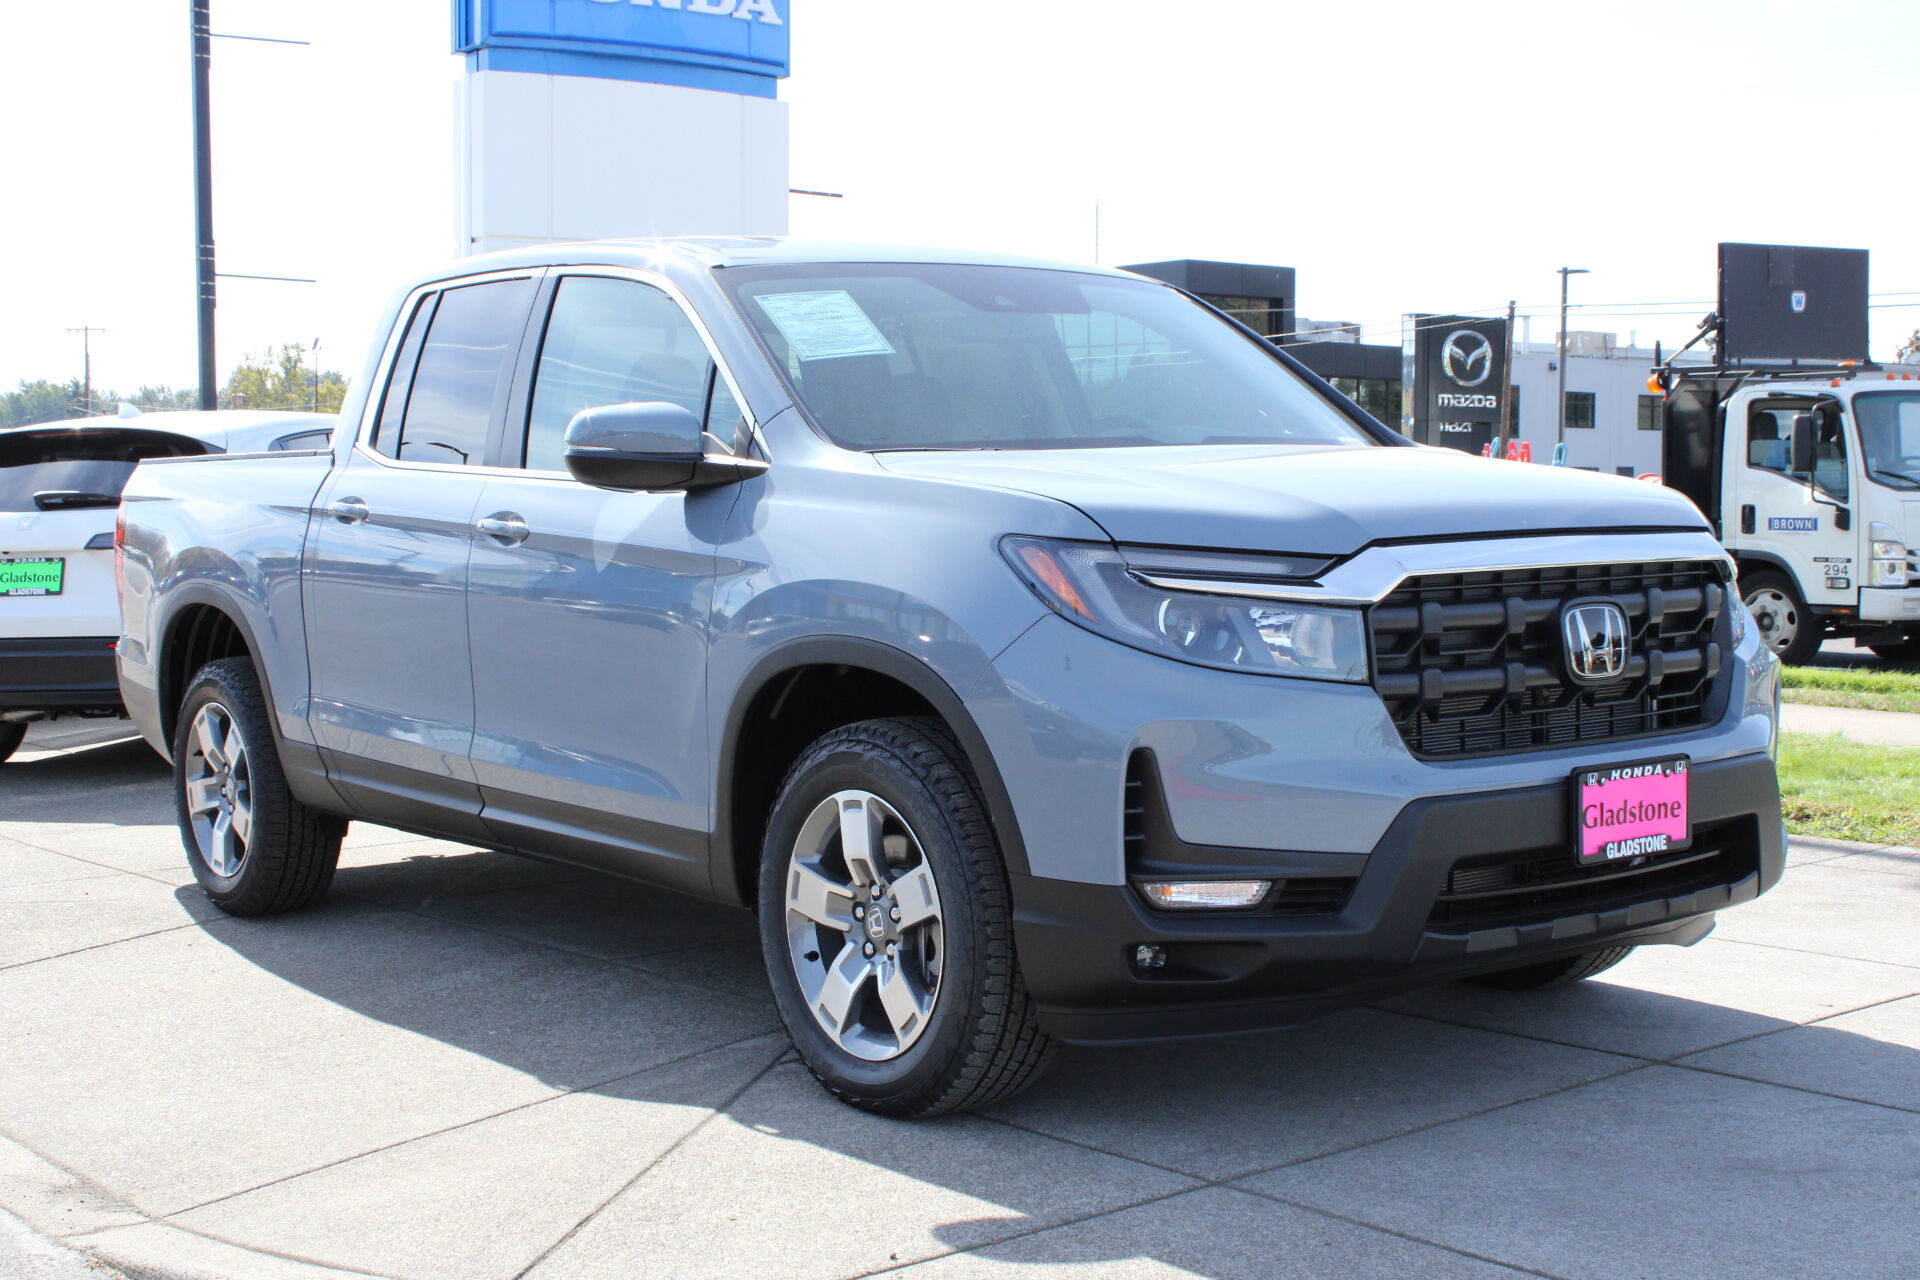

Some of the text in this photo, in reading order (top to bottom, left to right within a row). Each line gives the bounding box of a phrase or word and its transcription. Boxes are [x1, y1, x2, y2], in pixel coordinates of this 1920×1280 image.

[1437, 393, 1497, 408] mazda
[1773, 519, 1812, 530] BROWN
[1824, 564, 1848, 576] 294
[0, 571, 59, 583] Gladstone
[9, 588, 46, 596] GLADSTONE
[1610, 764, 1663, 781] HONDA
[1583, 799, 1682, 829] Gladstone
[1606, 833, 1668, 860] GLADSTONE
